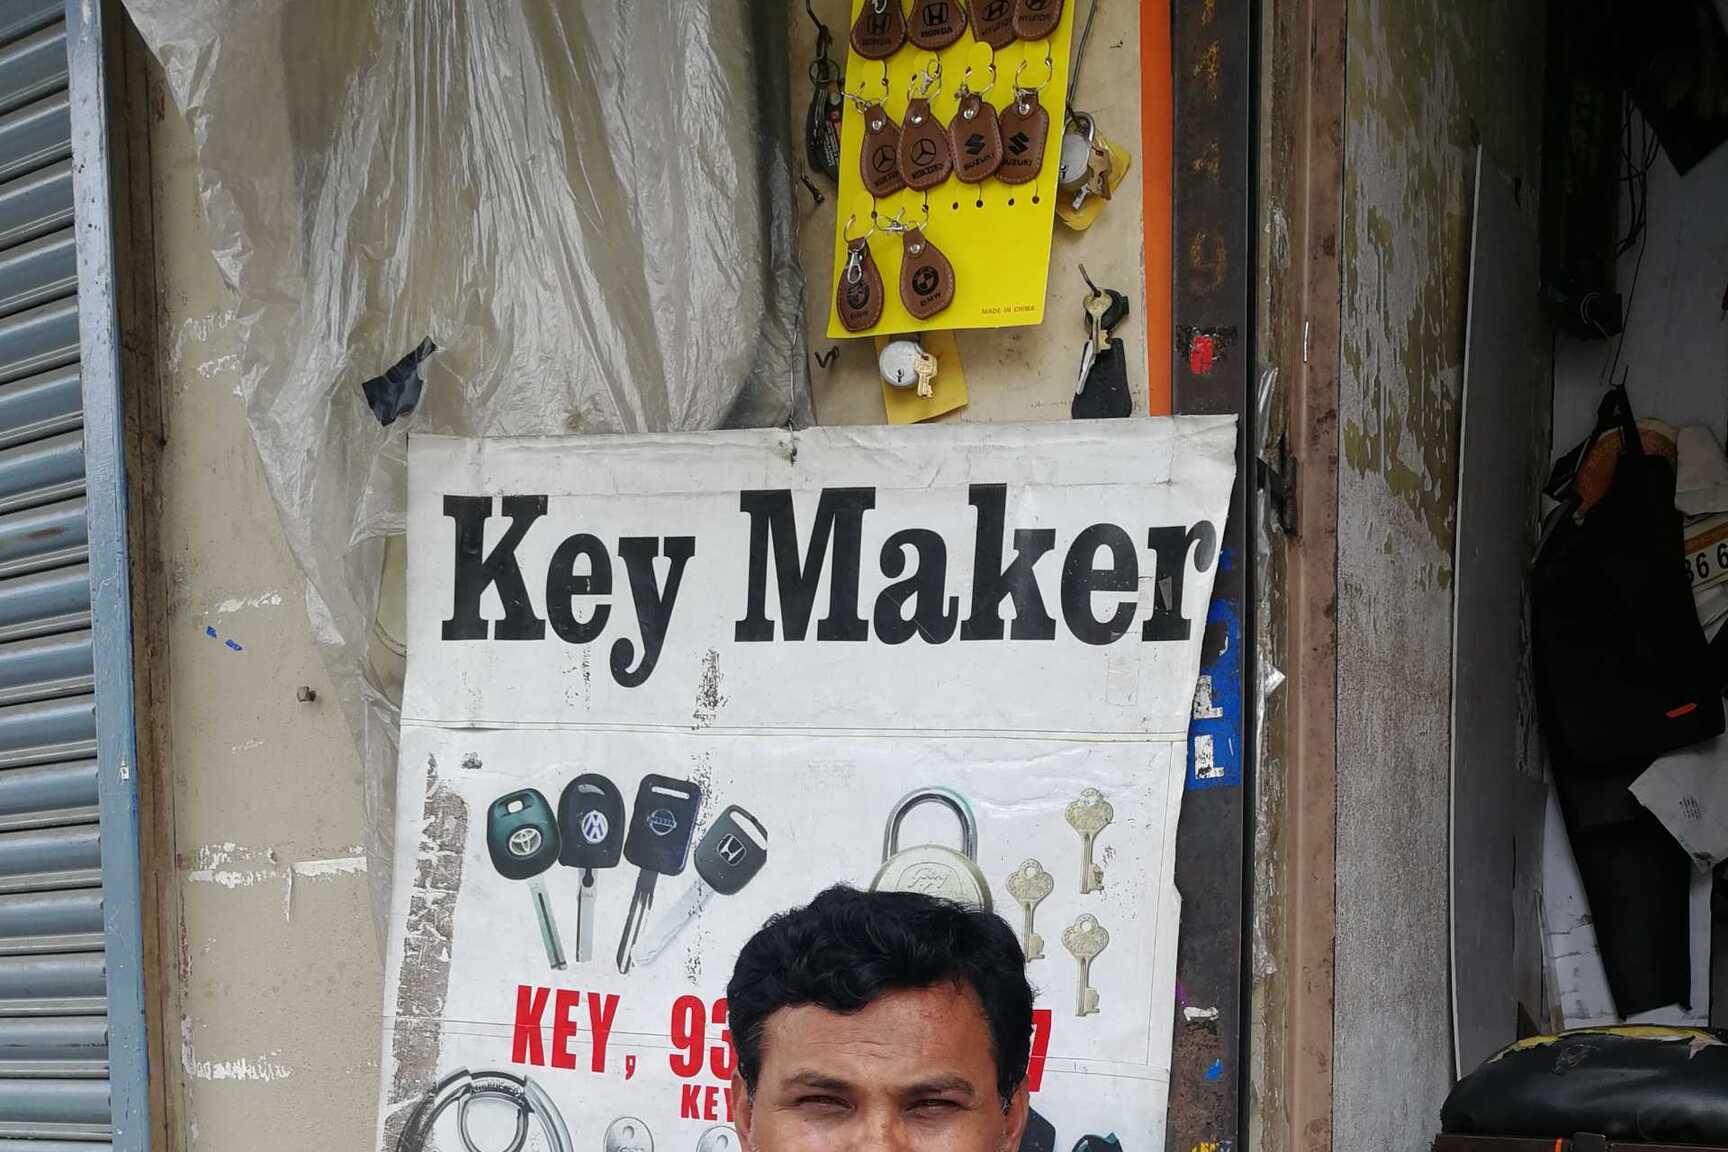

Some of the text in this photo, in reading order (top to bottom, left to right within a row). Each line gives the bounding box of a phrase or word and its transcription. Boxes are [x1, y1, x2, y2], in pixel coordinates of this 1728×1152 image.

[441, 482, 1217, 688] Key Maker
[511, 984, 636, 1081] KEY,
